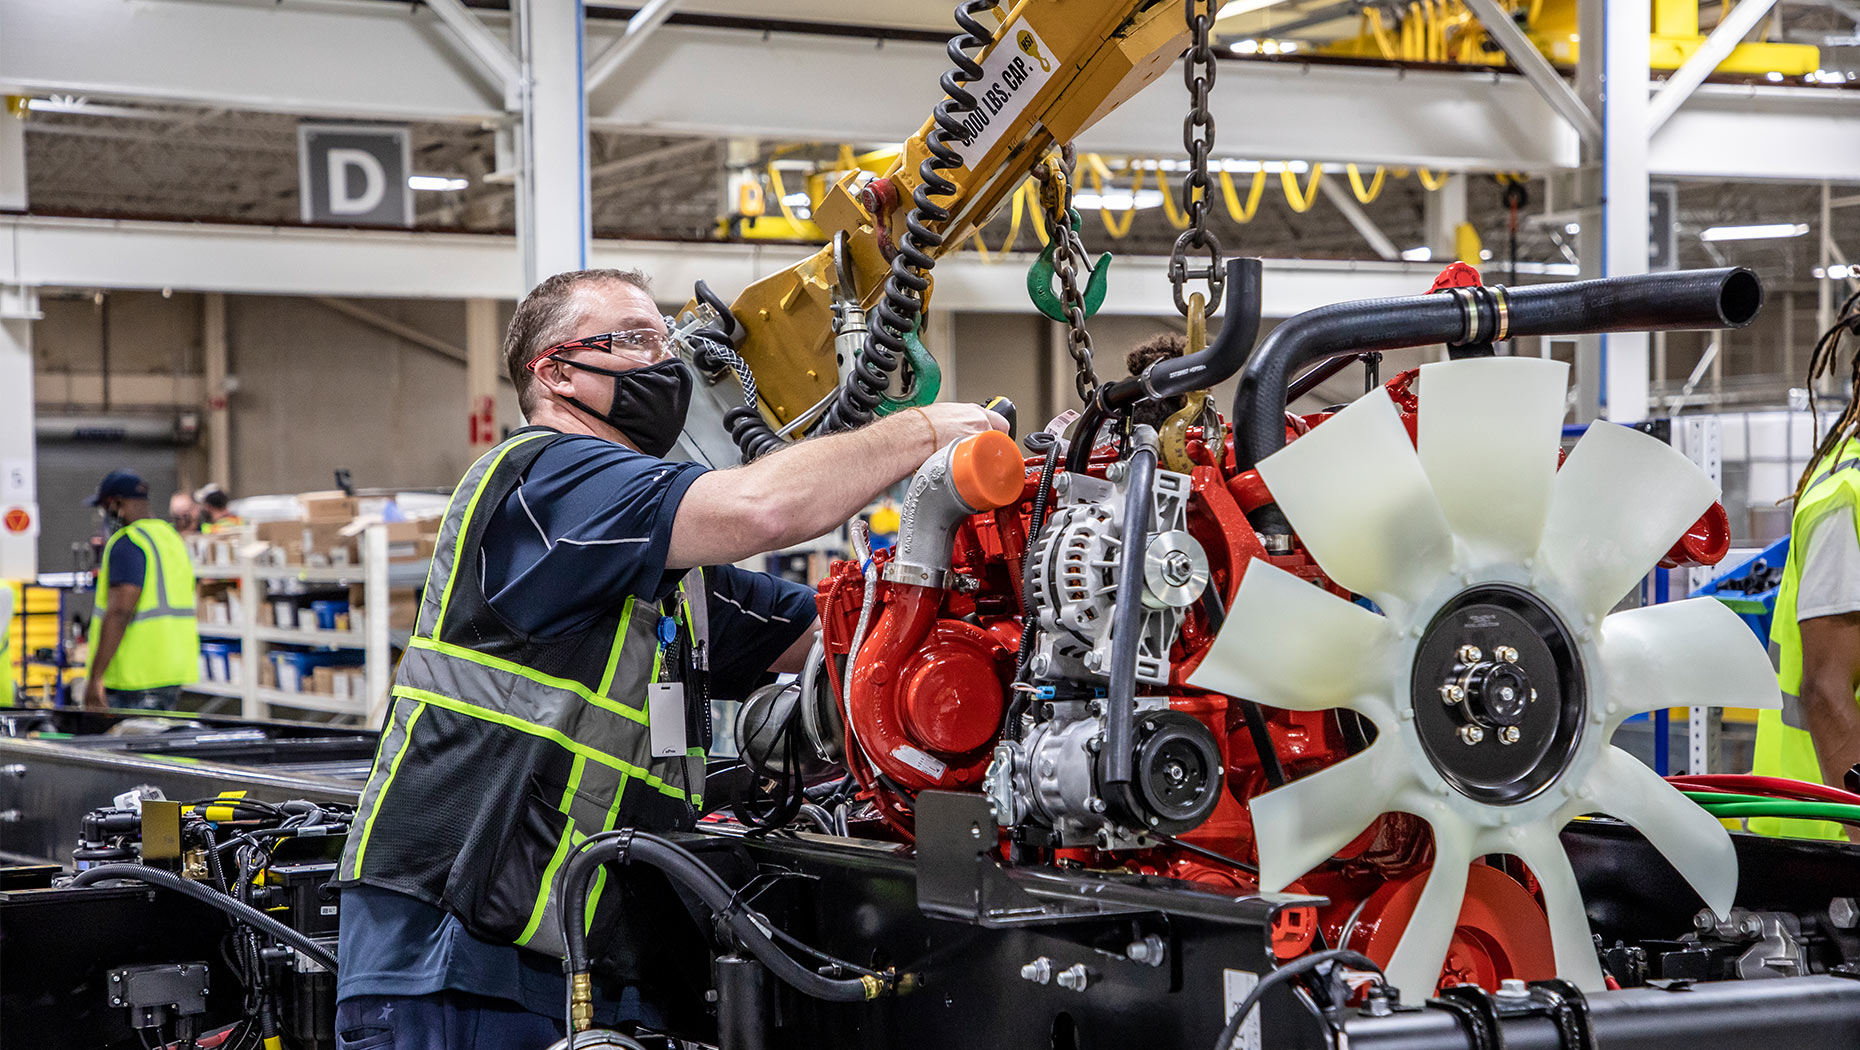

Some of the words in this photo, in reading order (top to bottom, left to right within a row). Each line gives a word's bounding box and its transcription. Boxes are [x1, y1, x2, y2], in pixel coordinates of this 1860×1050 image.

[1020, 33, 1034, 51] HSI
[981, 82, 1012, 116] LBS.
[1001, 56, 1034, 91] CAP.
[327, 149, 387, 215] D
